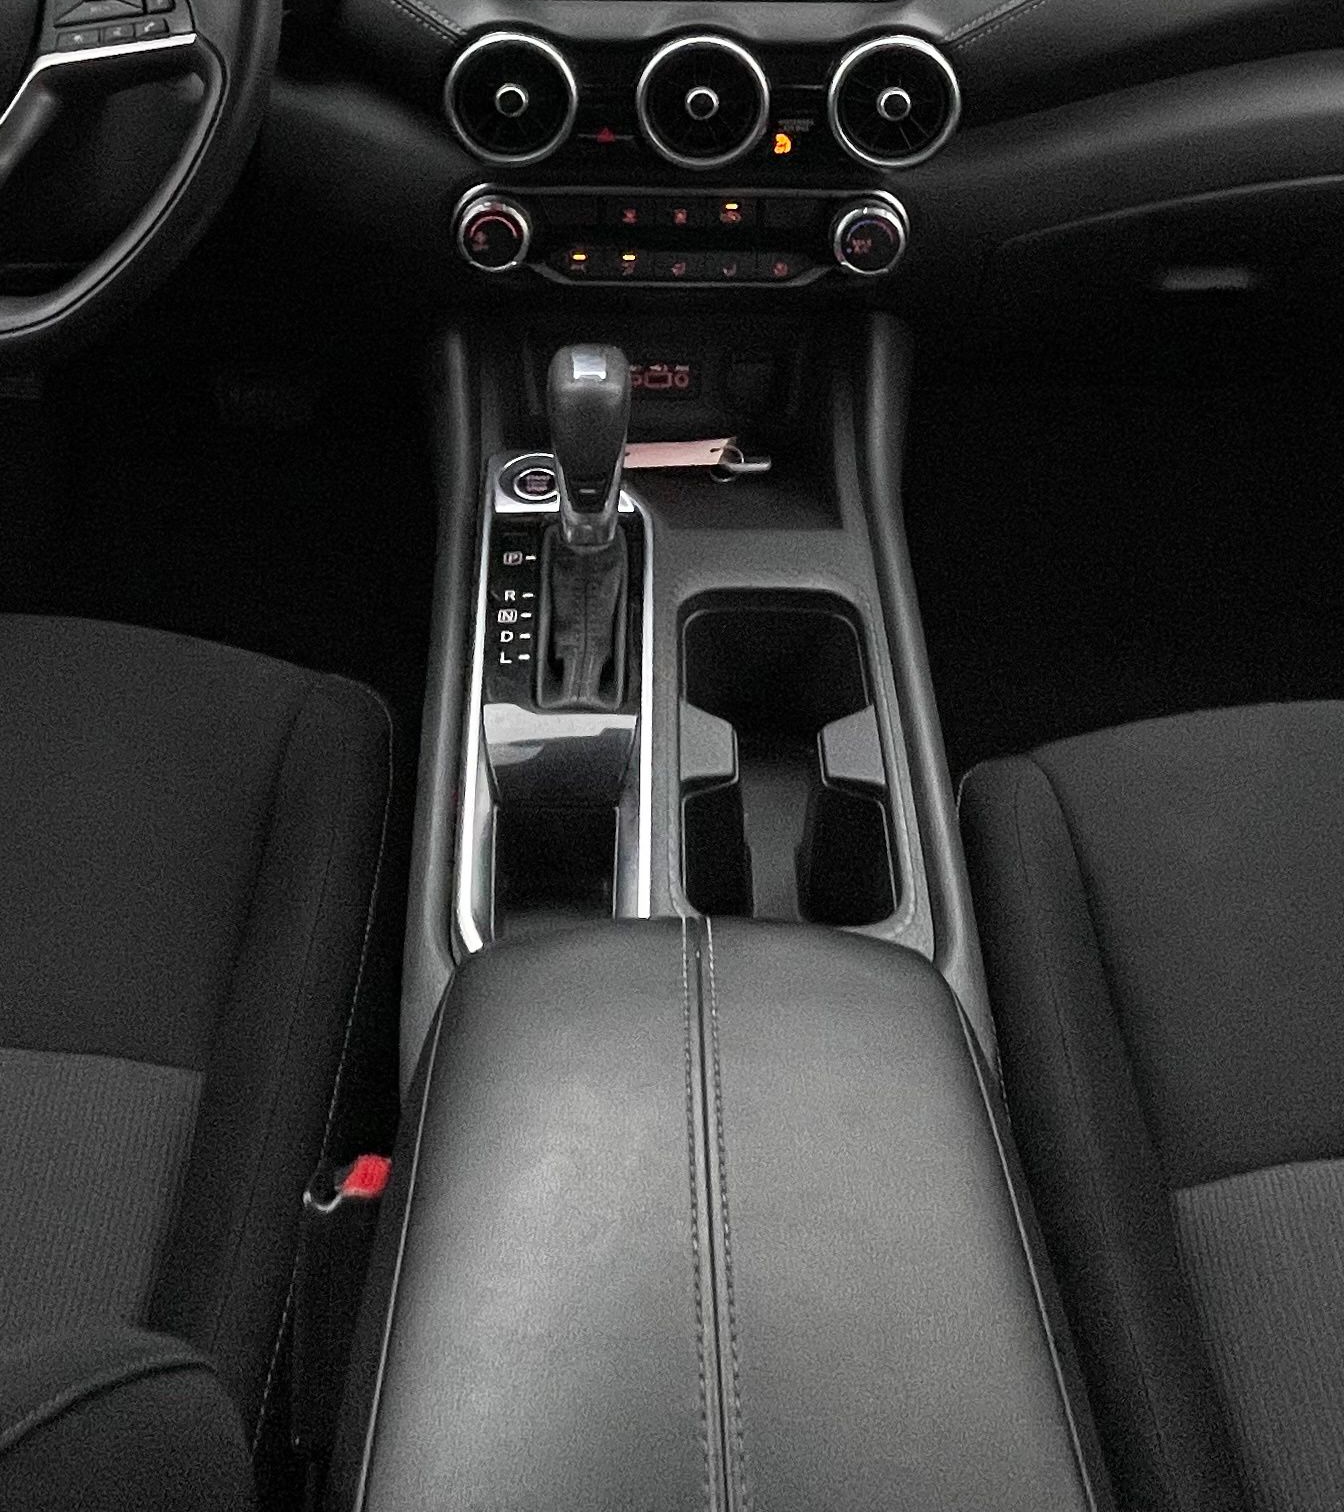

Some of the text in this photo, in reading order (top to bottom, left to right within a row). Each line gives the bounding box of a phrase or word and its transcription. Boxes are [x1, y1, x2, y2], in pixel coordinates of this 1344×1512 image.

[504, 590, 516, 601] R
[500, 630, 514, 643] D
[499, 651, 513, 664] L
